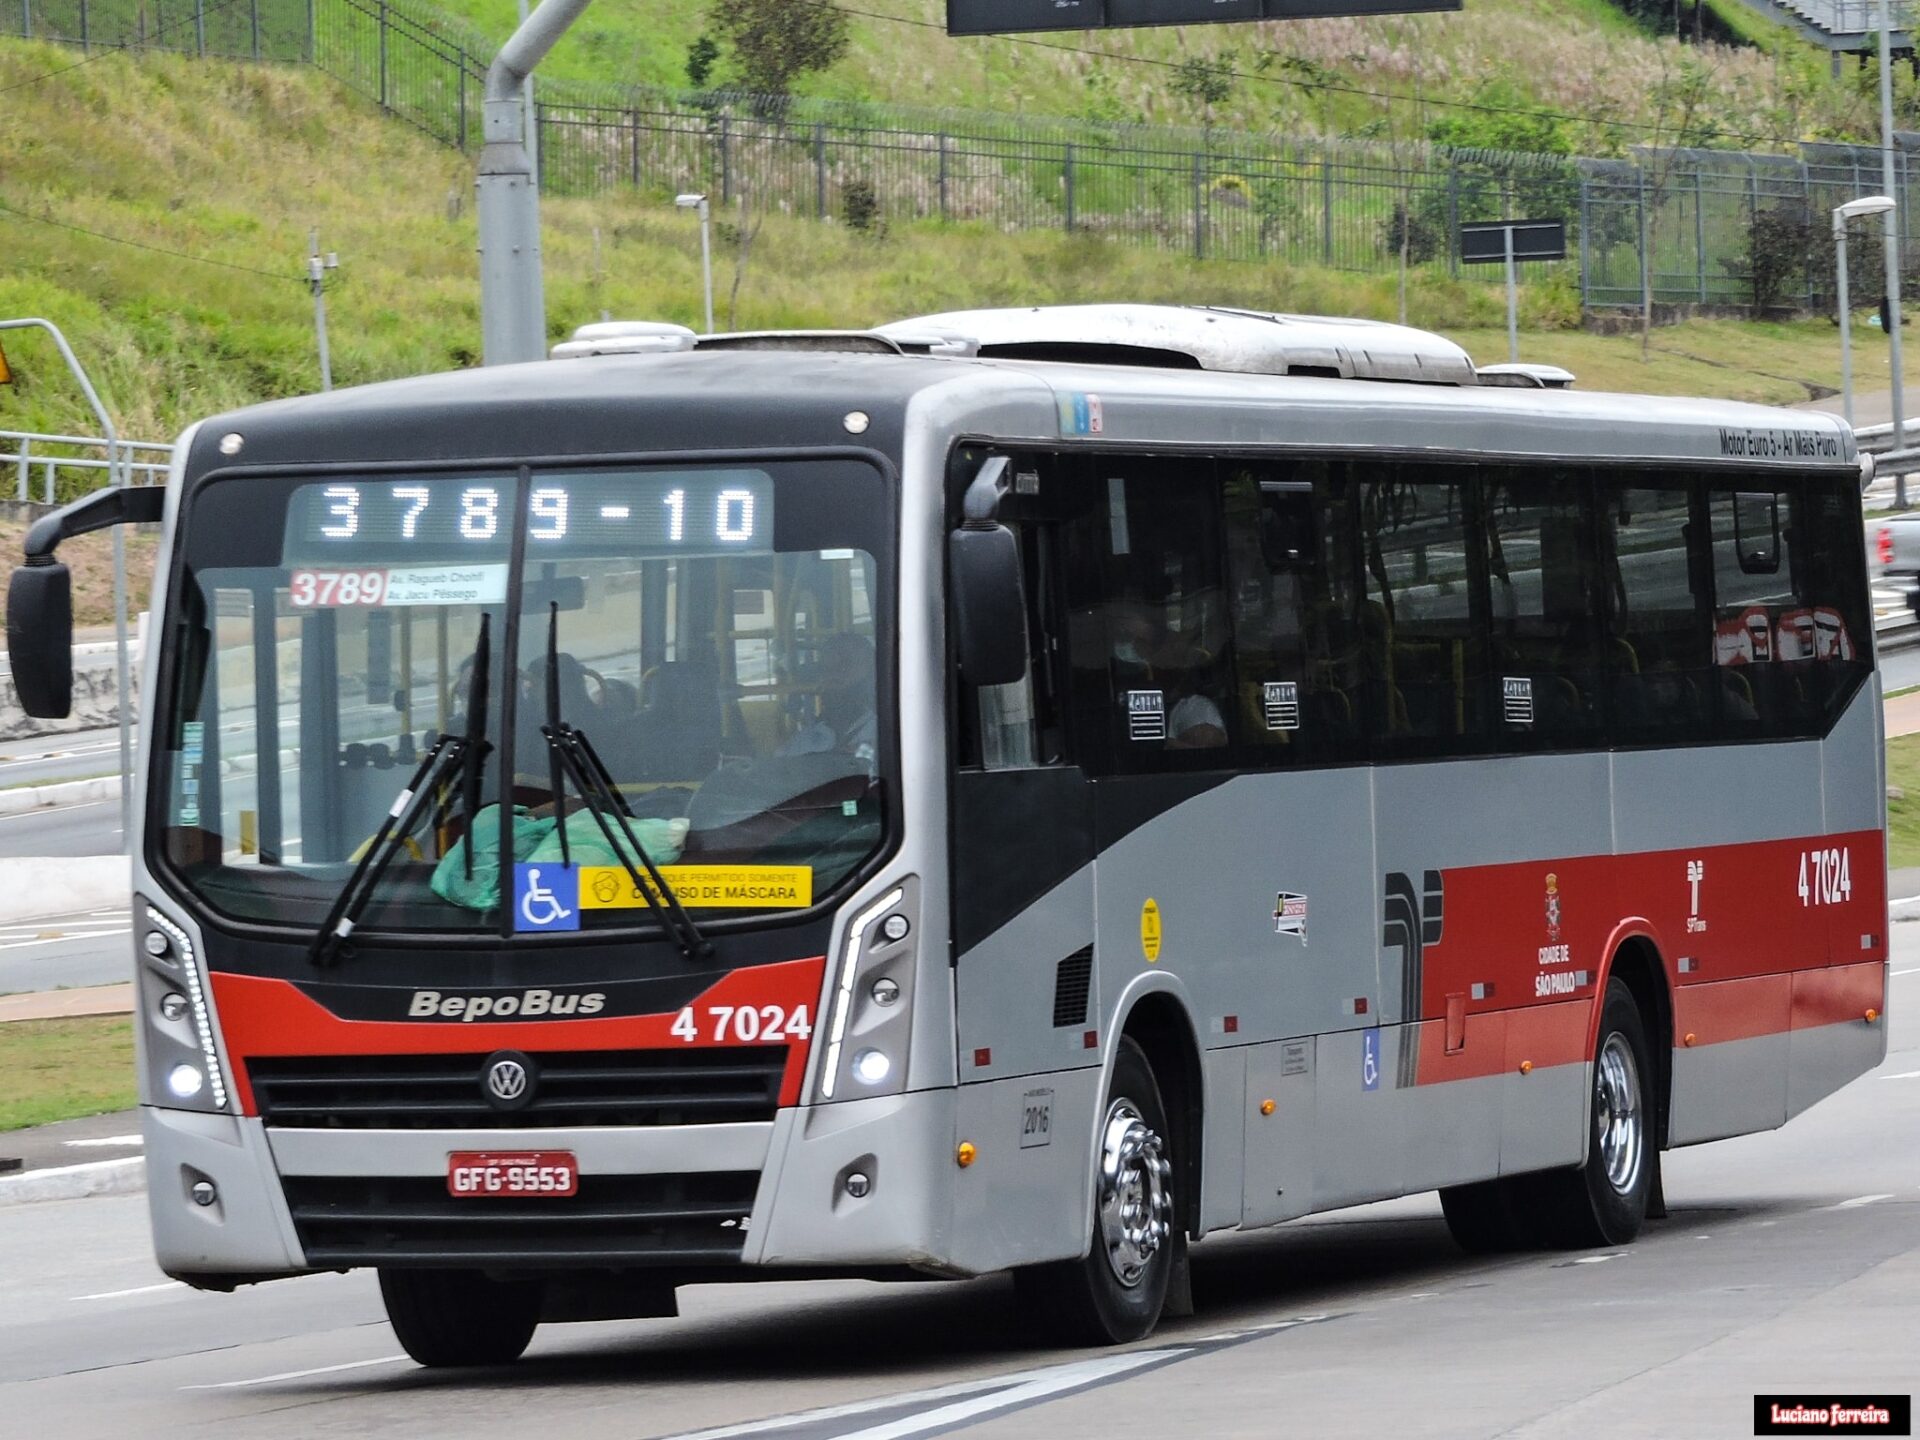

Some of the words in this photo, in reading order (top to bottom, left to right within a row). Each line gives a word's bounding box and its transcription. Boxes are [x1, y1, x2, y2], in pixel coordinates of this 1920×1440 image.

[1719, 428, 1745, 455] Motor
[1747, 430, 1768, 456] Euro
[1769, 431, 1776, 457] 5
[1783, 431, 1792, 457] Ar
[1793, 431, 1814, 457] Mais
[1815, 431, 1837, 457] Puro
[293, 572, 384, 606] 3789
[405, 590, 429, 600] Jacu
[691, 873, 745, 882] PERMITIDO
[748, 873, 798, 882] SOMENTE
[703, 886, 720, 899] DE
[725, 884, 797, 899] MÁSCARA
[1798, 852, 1809, 907] 4
[1811, 847, 1851, 905] 7024
[1538, 945, 1560, 964] CIDADE
[1560, 944, 1569, 962] DE
[1535, 970, 1550, 997] SÃO
[1551, 971, 1575, 994] PAULO
[408, 989, 606, 1022] BepoBus
[670, 1005, 698, 1042] 4
[708, 1004, 812, 1041] 7024
[1023, 1105, 1049, 1134] 2016
